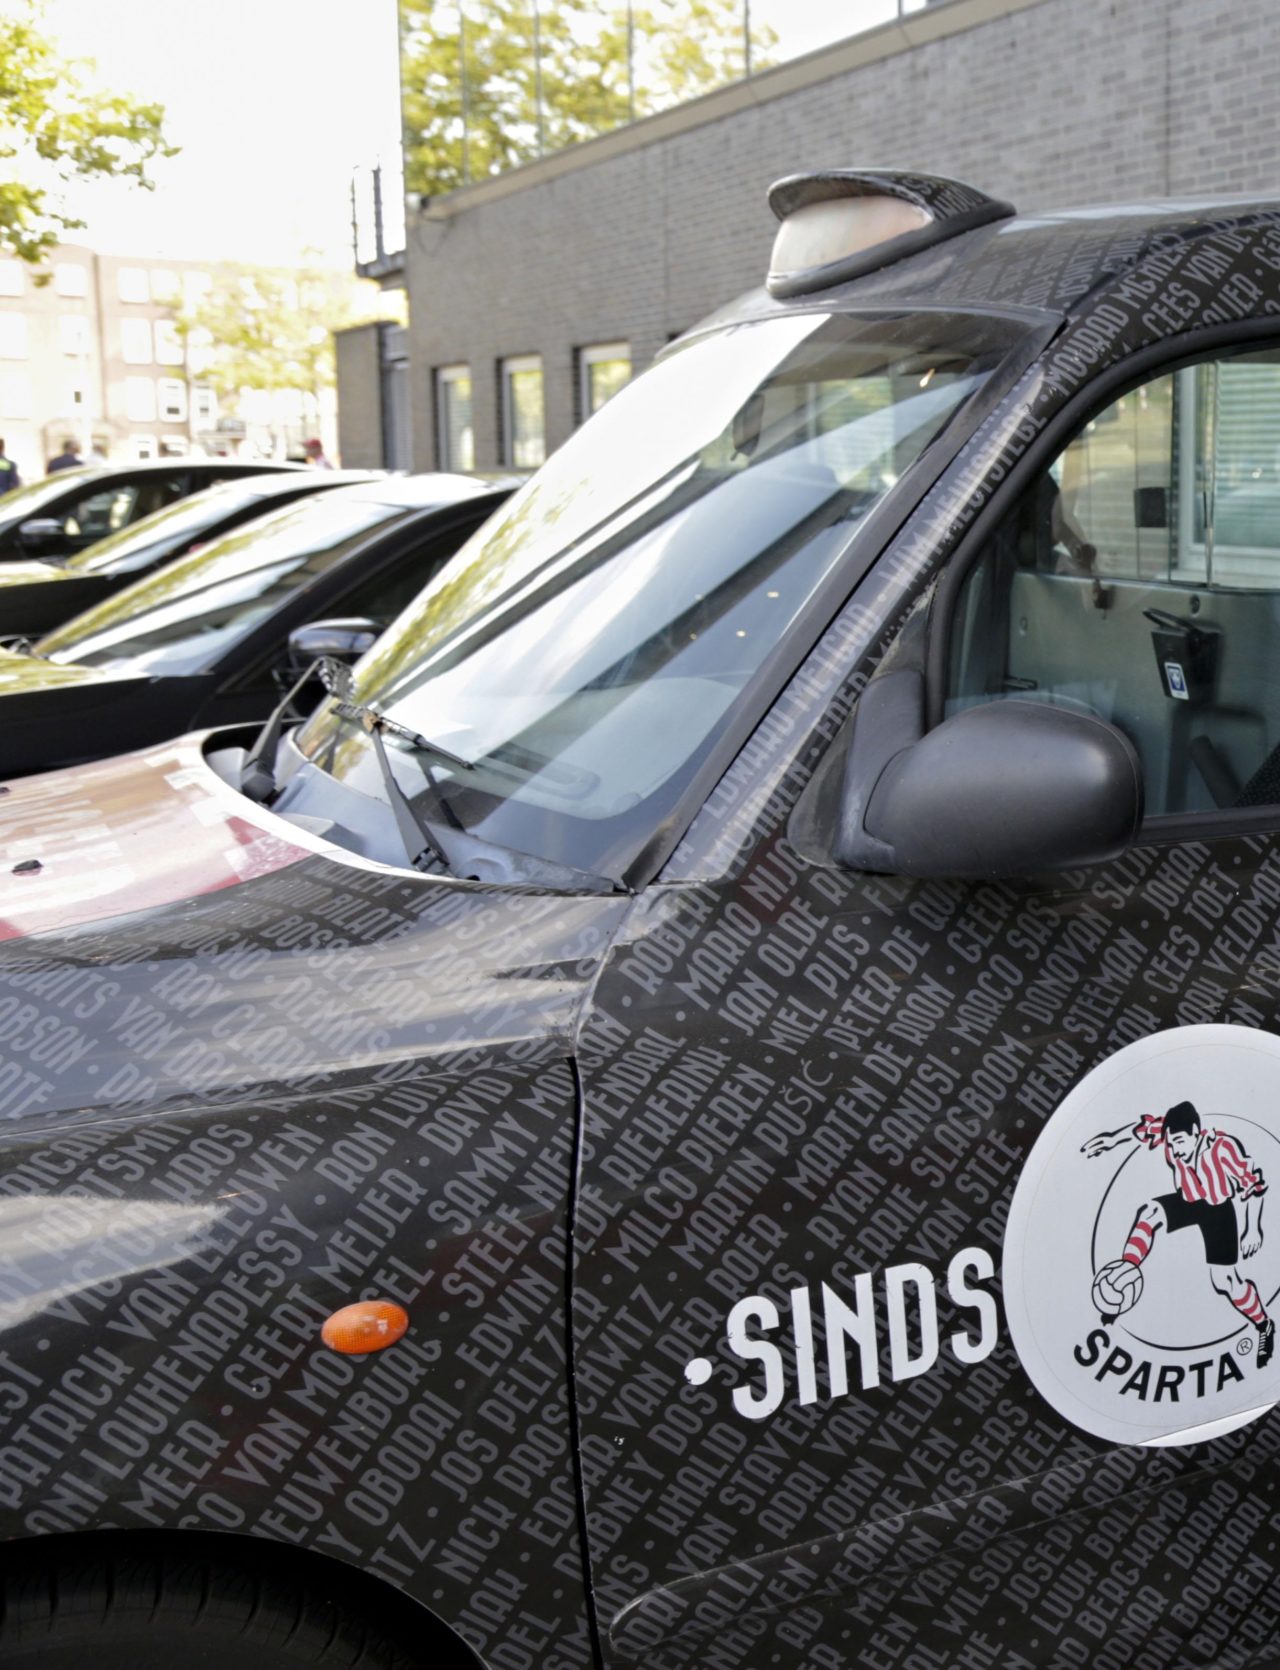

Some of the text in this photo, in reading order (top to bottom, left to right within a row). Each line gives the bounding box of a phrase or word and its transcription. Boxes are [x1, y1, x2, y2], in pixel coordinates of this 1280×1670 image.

[1182, 244, 1233, 285] VAN
[1044, 304, 1129, 396] MOURAD
[1140, 842, 1212, 921] JOHAN
[1143, 862, 1240, 994] CEES TOET
[152, 962, 234, 1019] RAY
[674, 901, 761, 1010] MARIO
[718, 968, 779, 1036] JAN
[758, 895, 829, 978] OLDE
[760, 995, 828, 1055] MIEL
[803, 924, 870, 999] PIJS
[824, 965, 902, 1050] PETER
[880, 925, 931, 976] DE
[948, 898, 1062, 1047] MARCO SAS
[1016, 901, 1113, 1025] DONOVAN
[106, 995, 186, 1060] VAN
[1015, 1038, 1084, 1119] HENK
[1062, 926, 1149, 1044] STEEMAN
[417, 1074, 514, 1156] DAVID
[782, 971, 957, 1201] MARTEN DE ROON
[911, 1031, 1035, 1189] SLAGBOOM
[151, 1123, 253, 1206] KROS
[313, 1120, 397, 1194] RON
[427, 1109, 539, 1236] SAMMY
[603, 1062, 776, 1274] MILCO PIEREN
[668, 1147, 776, 1270] MARTIN
[806, 1158, 888, 1249] RYAN
[868, 1053, 962, 1167] SANUSI
[904, 1198, 973, 1261] VAN
[954, 1129, 1023, 1205] STEE
[105, 1265, 200, 1342] VAN
[173, 1121, 326, 1273] LEEUWEN
[441, 1202, 537, 1308] STEEF
[455, 1264, 560, 1377] EDWIN
[599, 1045, 732, 1191] RIEKERINK
[80, 1203, 319, 1481] LOUHENAPESSY
[223, 1283, 333, 1400] GEERT
[309, 1168, 430, 1294] MEIJER
[601, 1361, 677, 1429] VAN
[654, 1296, 726, 1368] DER
[705, 1213, 789, 1301] ROER
[726, 1247, 998, 1421] SINDS
[647, 1384, 718, 1457] DOS
[1074, 1329, 1245, 1402] SPARTA
[0, 1345, 136, 1510] PATRICK
[120, 1419, 231, 1528] MEER
[222, 1407, 311, 1487] VAN
[345, 1391, 462, 1527] OBODAI
[431, 1429, 499, 1503] JOS
[645, 1421, 748, 1536] KHALID
[757, 1460, 831, 1540] ADRI
[812, 1394, 880, 1456] VAN
[920, 1398, 1030, 1522] VISSERS
[433, 1496, 517, 1584] NICK
[666, 1512, 738, 1577] VAN
[813, 1456, 887, 1542] JOHN
[901, 1554, 965, 1607] VAN
[953, 1495, 1014, 1550] DER
[1165, 1479, 1240, 1570] DARKO
[932, 1532, 1029, 1635] WILSON
[1001, 1511, 1092, 1614] JOSEPH
[1031, 1558, 1099, 1636] LUUK
[1075, 1489, 1188, 1640] BERGKAMP
[1170, 1493, 1271, 1630] BOUKHARI
[1189, 1552, 1275, 1658] BUEREN
[775, 1605, 824, 1650] AD
